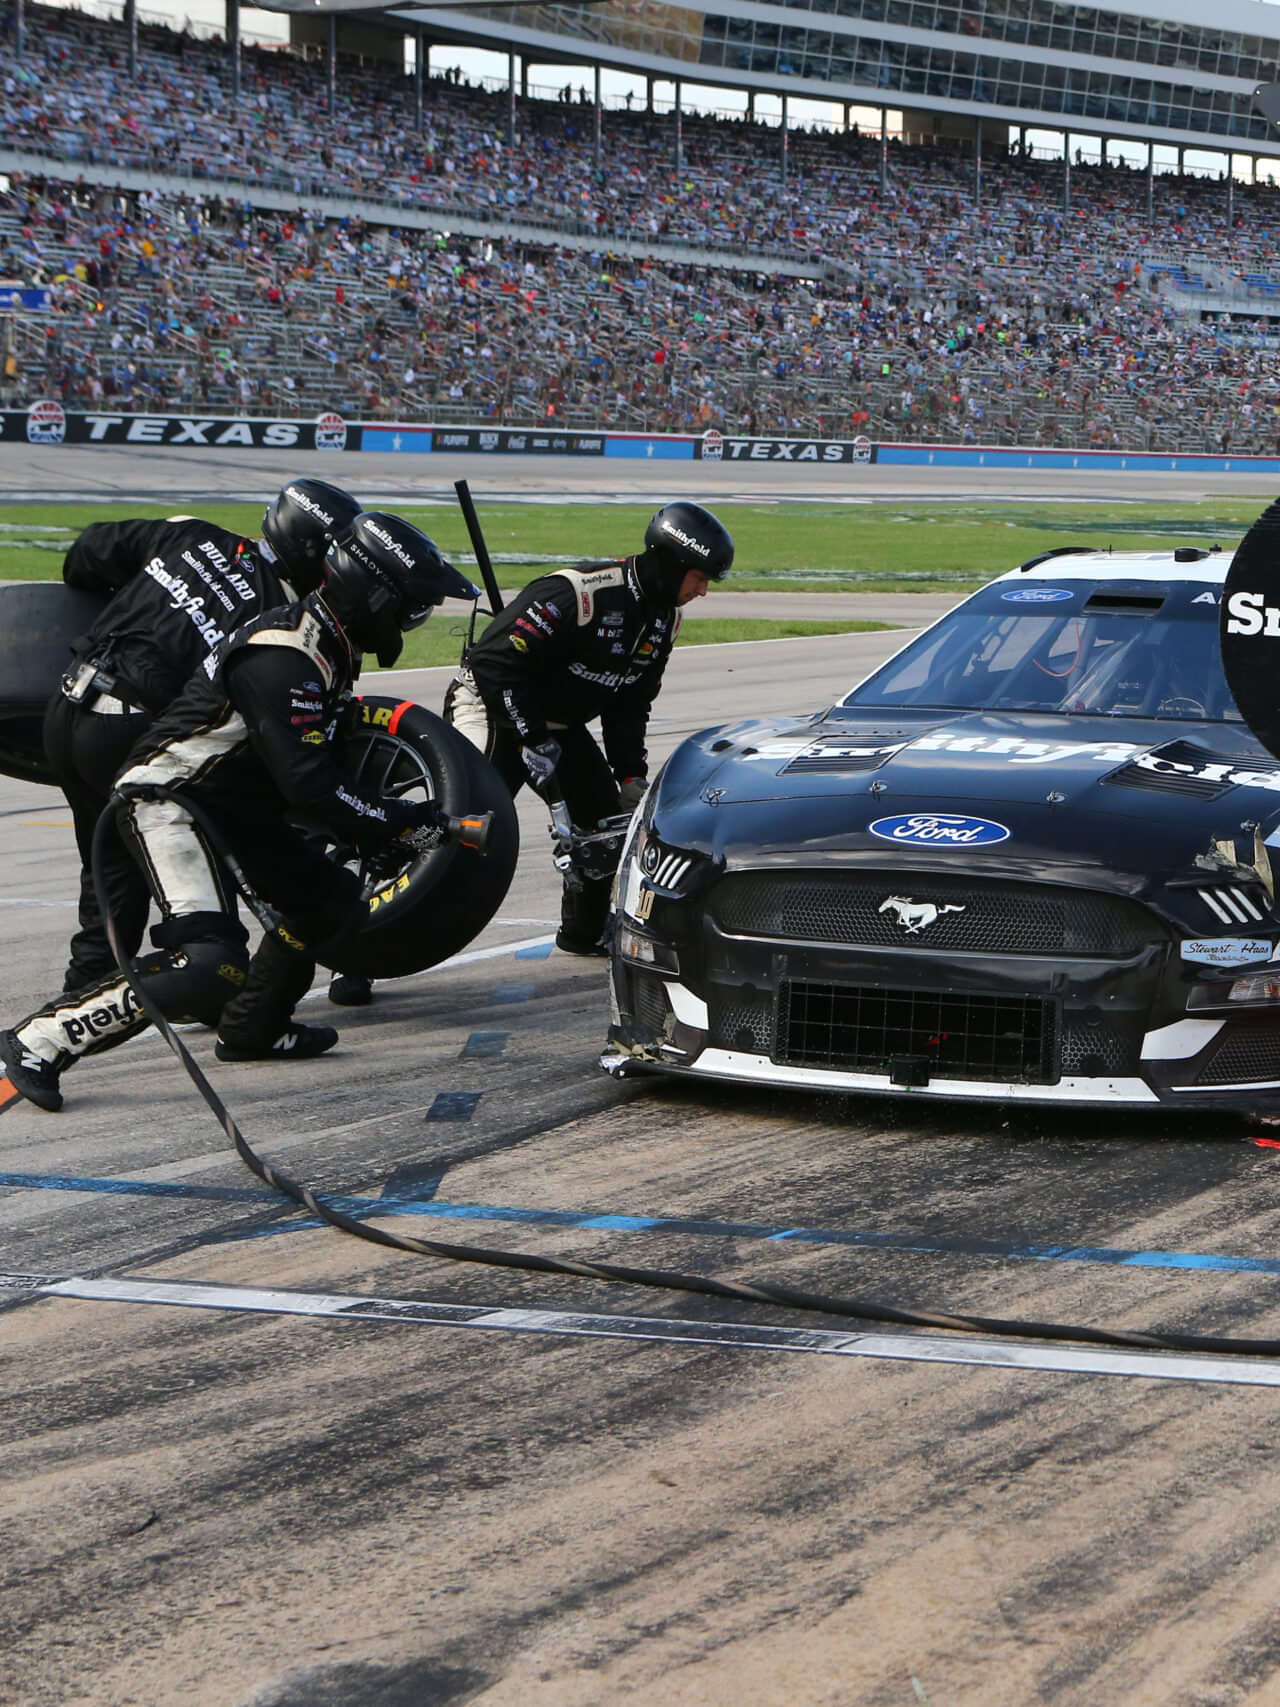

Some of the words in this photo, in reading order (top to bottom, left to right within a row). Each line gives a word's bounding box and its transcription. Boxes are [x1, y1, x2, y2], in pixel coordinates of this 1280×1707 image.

[85, 416, 299, 447] TEXAS
[728, 441, 844, 461] TEXAS
[286, 486, 334, 526] Smithfield
[363, 519, 416, 569] Smithfield
[661, 520, 711, 558] Smithfield
[144, 556, 225, 649] Smithfield
[893, 816, 985, 842] Ford
[1184, 942, 1235, 954] Stewart
